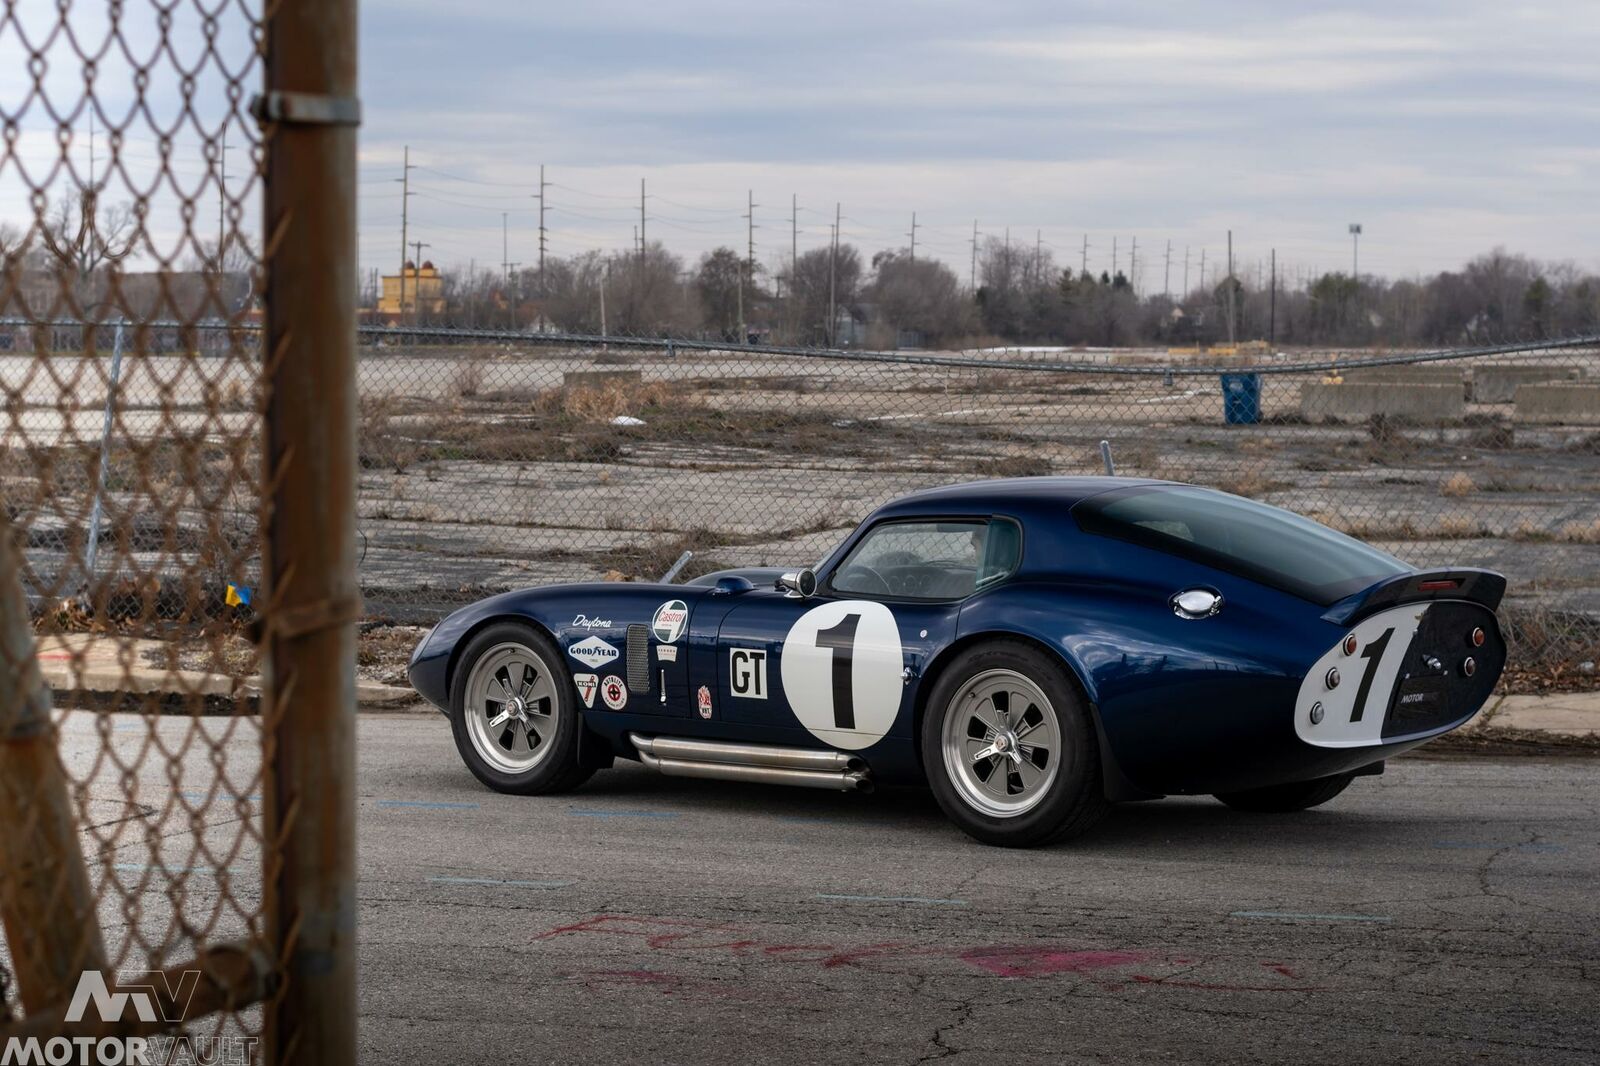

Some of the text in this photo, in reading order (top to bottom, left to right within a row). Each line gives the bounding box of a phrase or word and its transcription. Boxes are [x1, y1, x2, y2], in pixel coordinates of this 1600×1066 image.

[572, 614, 612, 631] Daytona
[658, 611, 685, 623] Castrol
[731, 650, 765, 695] GT
[815, 613, 861, 730] 1
[1349, 627, 1396, 723] 1
